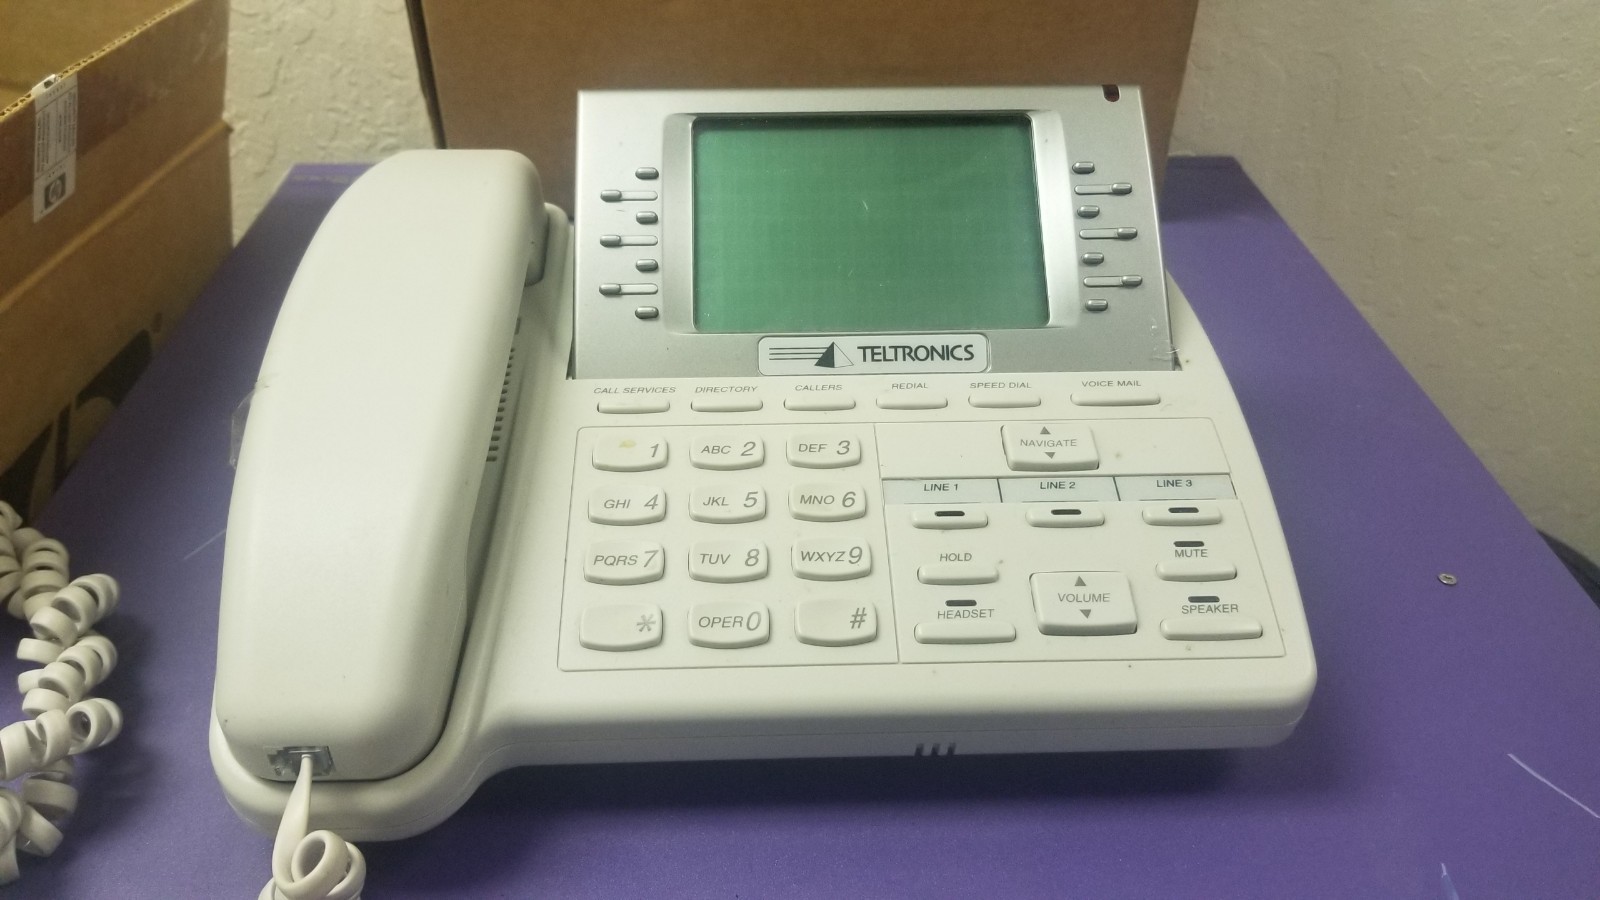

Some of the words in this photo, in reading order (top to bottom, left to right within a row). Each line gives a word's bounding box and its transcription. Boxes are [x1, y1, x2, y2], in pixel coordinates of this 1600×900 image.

[857, 344, 975, 363] TELTRONICS
[694, 384, 758, 394] DIRECTORY
[794, 384, 844, 392] CALLERS
[891, 382, 928, 390] REDIAL
[970, 382, 1006, 390] SPEED
[1082, 380, 1114, 388] VOICE
[1116, 380, 1142, 388] MAIL
[592, 386, 620, 394] CALL
[622, 386, 676, 394] SERVICES
[798, 443, 828, 453] DEF
[836, 440, 851, 455] 3
[1020, 438, 1078, 448] NAVIGATE
[650, 443, 660, 458] 1
[701, 445, 732, 455] ABC
[741, 441, 757, 457] 2
[924, 484, 950, 492] LINE
[1040, 482, 1066, 490] LINE
[1068, 482, 1076, 490] 2
[1156, 480, 1182, 488] LINE
[1184, 480, 1194, 488] 3
[604, 499, 631, 509] GHI
[644, 494, 659, 510] 4
[703, 496, 729, 506] JKL
[743, 491, 758, 508] 5
[800, 495, 835, 505] MNO
[842, 491, 856, 507] 6
[701, 553, 731, 565] TUV
[744, 548, 760, 567] 8
[800, 551, 845, 562] WXYZ
[848, 546, 863, 564] 9
[940, 552, 972, 562] HOLD
[1174, 548, 1208, 558] MUTE
[593, 555, 638, 566] PQRS
[644, 550, 659, 567] 7
[1056, 592, 1110, 603] VOLUME
[937, 609, 994, 619] HEADSET
[1181, 604, 1239, 614] SPEAKER
[698, 616, 743, 628] OPER
[746, 611, 761, 631] 0
[850, 608, 867, 629] #
